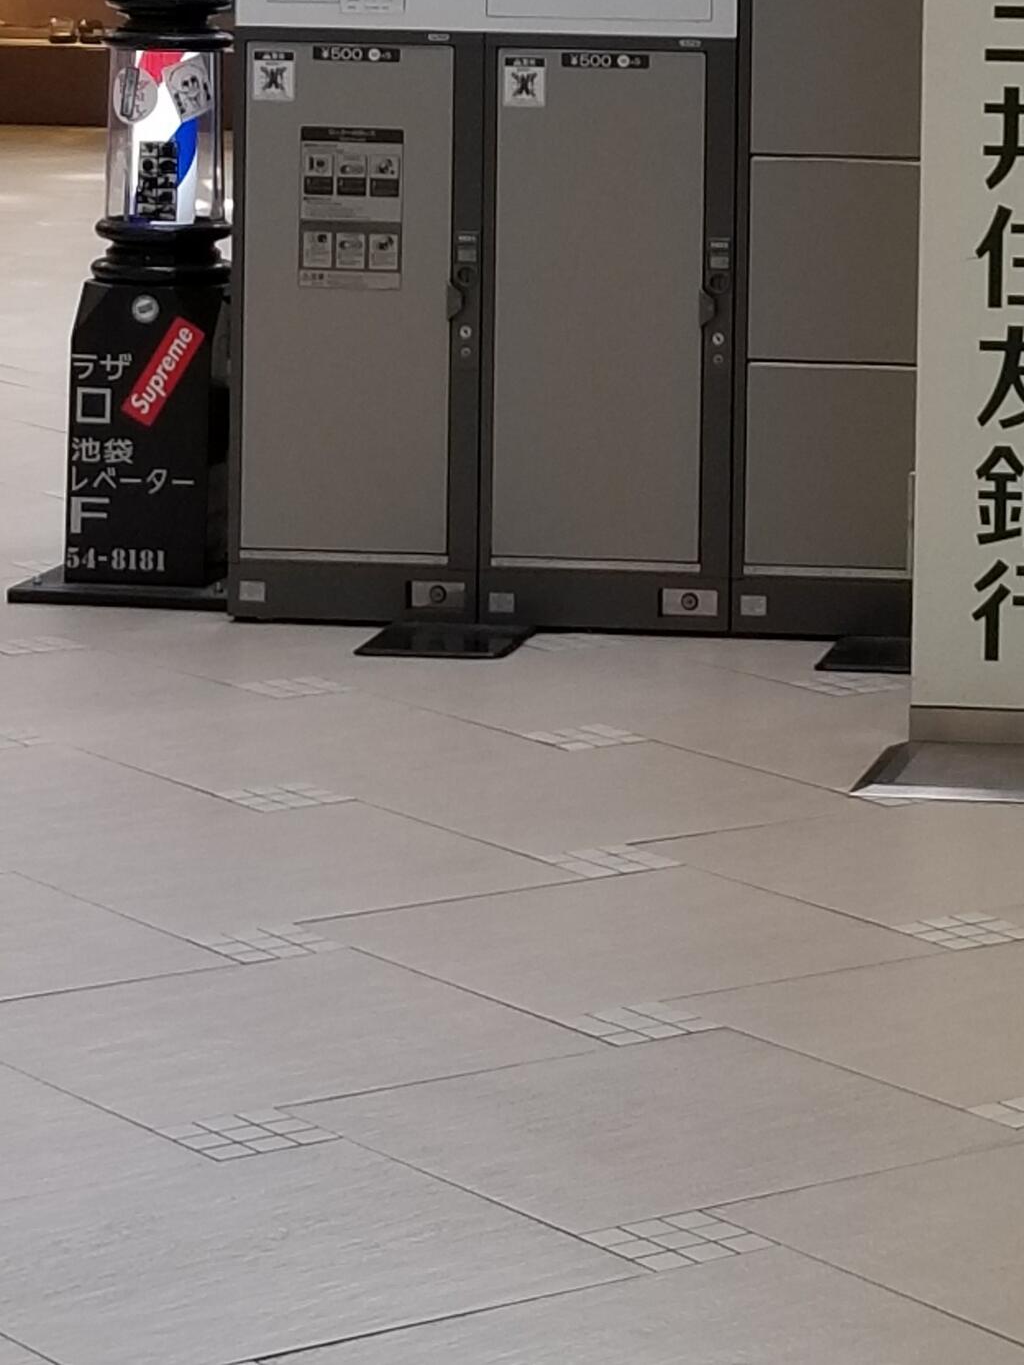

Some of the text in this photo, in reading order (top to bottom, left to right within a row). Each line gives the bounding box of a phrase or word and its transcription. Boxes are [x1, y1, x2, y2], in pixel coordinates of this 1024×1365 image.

[321, 47, 363, 62] ¥500
[569, 53, 612, 68] ¥500
[130, 325, 194, 415] Supreme
[71, 437, 134, 465] 池袋
